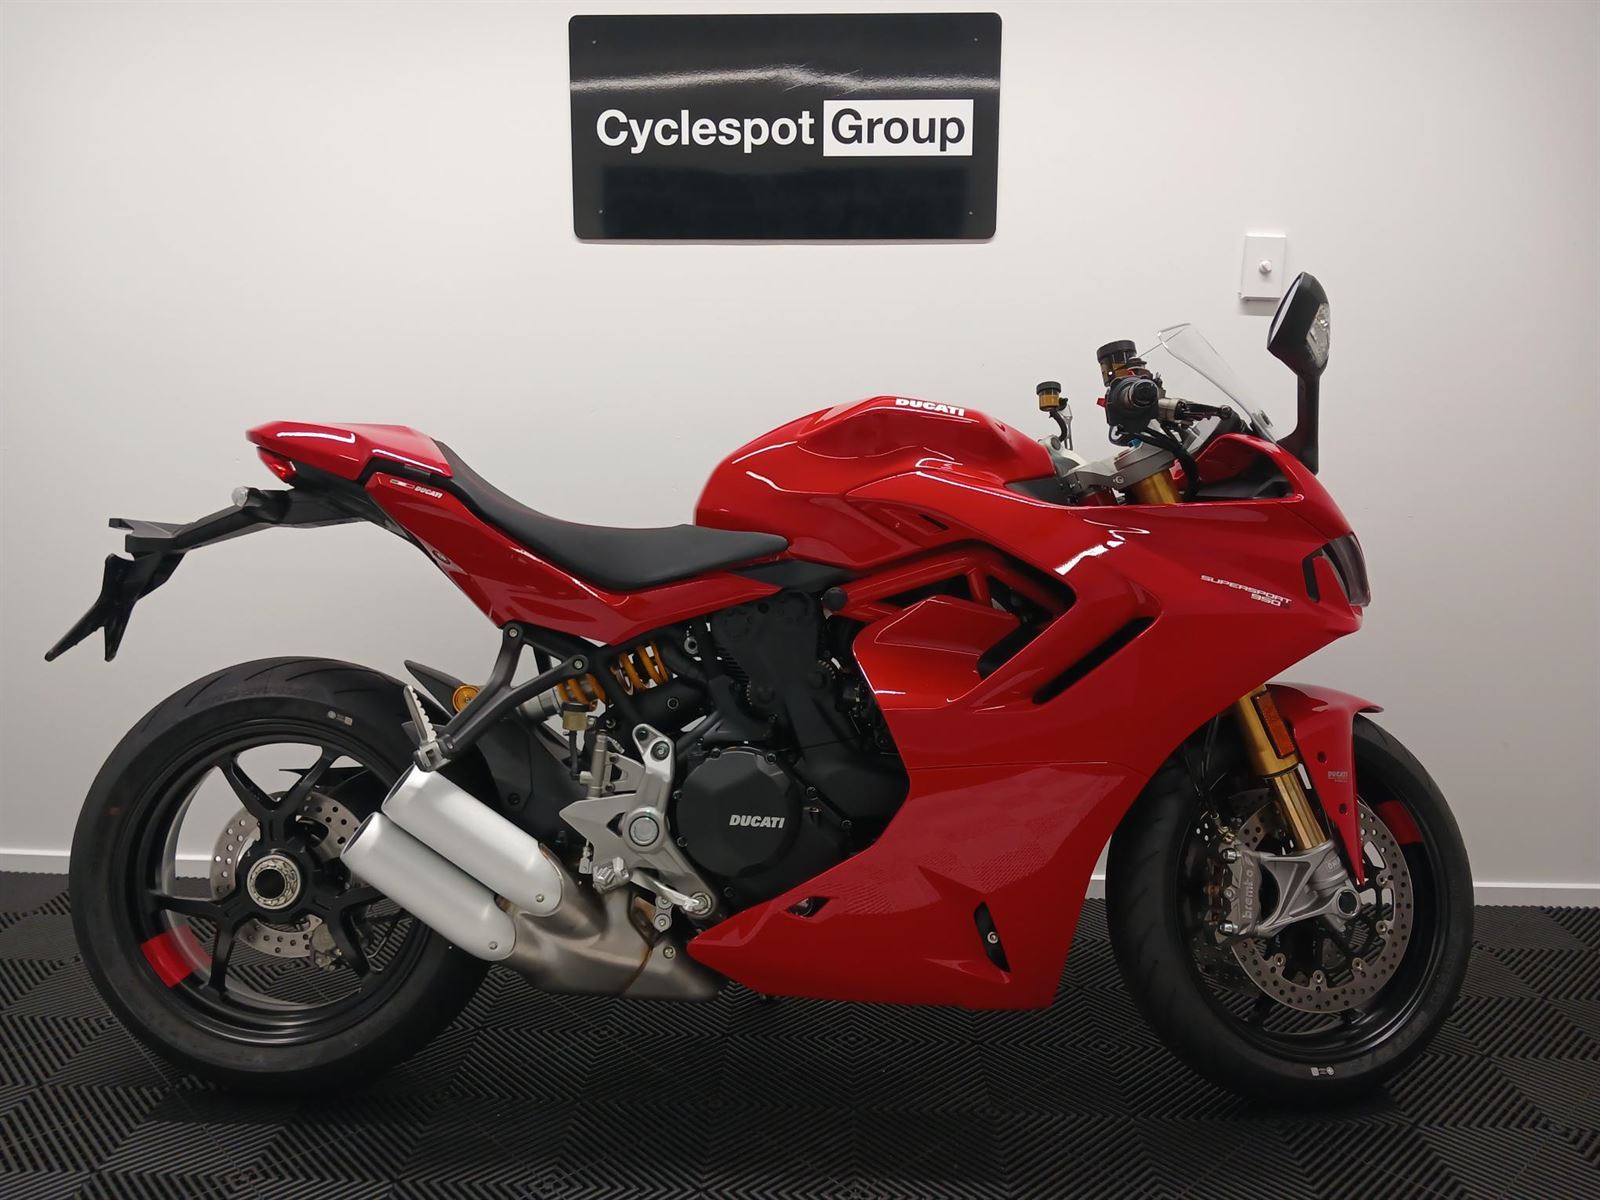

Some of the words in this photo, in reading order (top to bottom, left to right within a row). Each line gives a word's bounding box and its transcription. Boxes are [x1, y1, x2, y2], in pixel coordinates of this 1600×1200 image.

[596, 109, 815, 153] Cyclespot
[831, 108, 966, 152] Group
[895, 398, 965, 417] DUCATI
[414, 485, 443, 499] DUCATI
[1200, 574, 1292, 604] SUPERSPORT
[1250, 593, 1281, 607] 950
[728, 814, 785, 829] DUCATI
